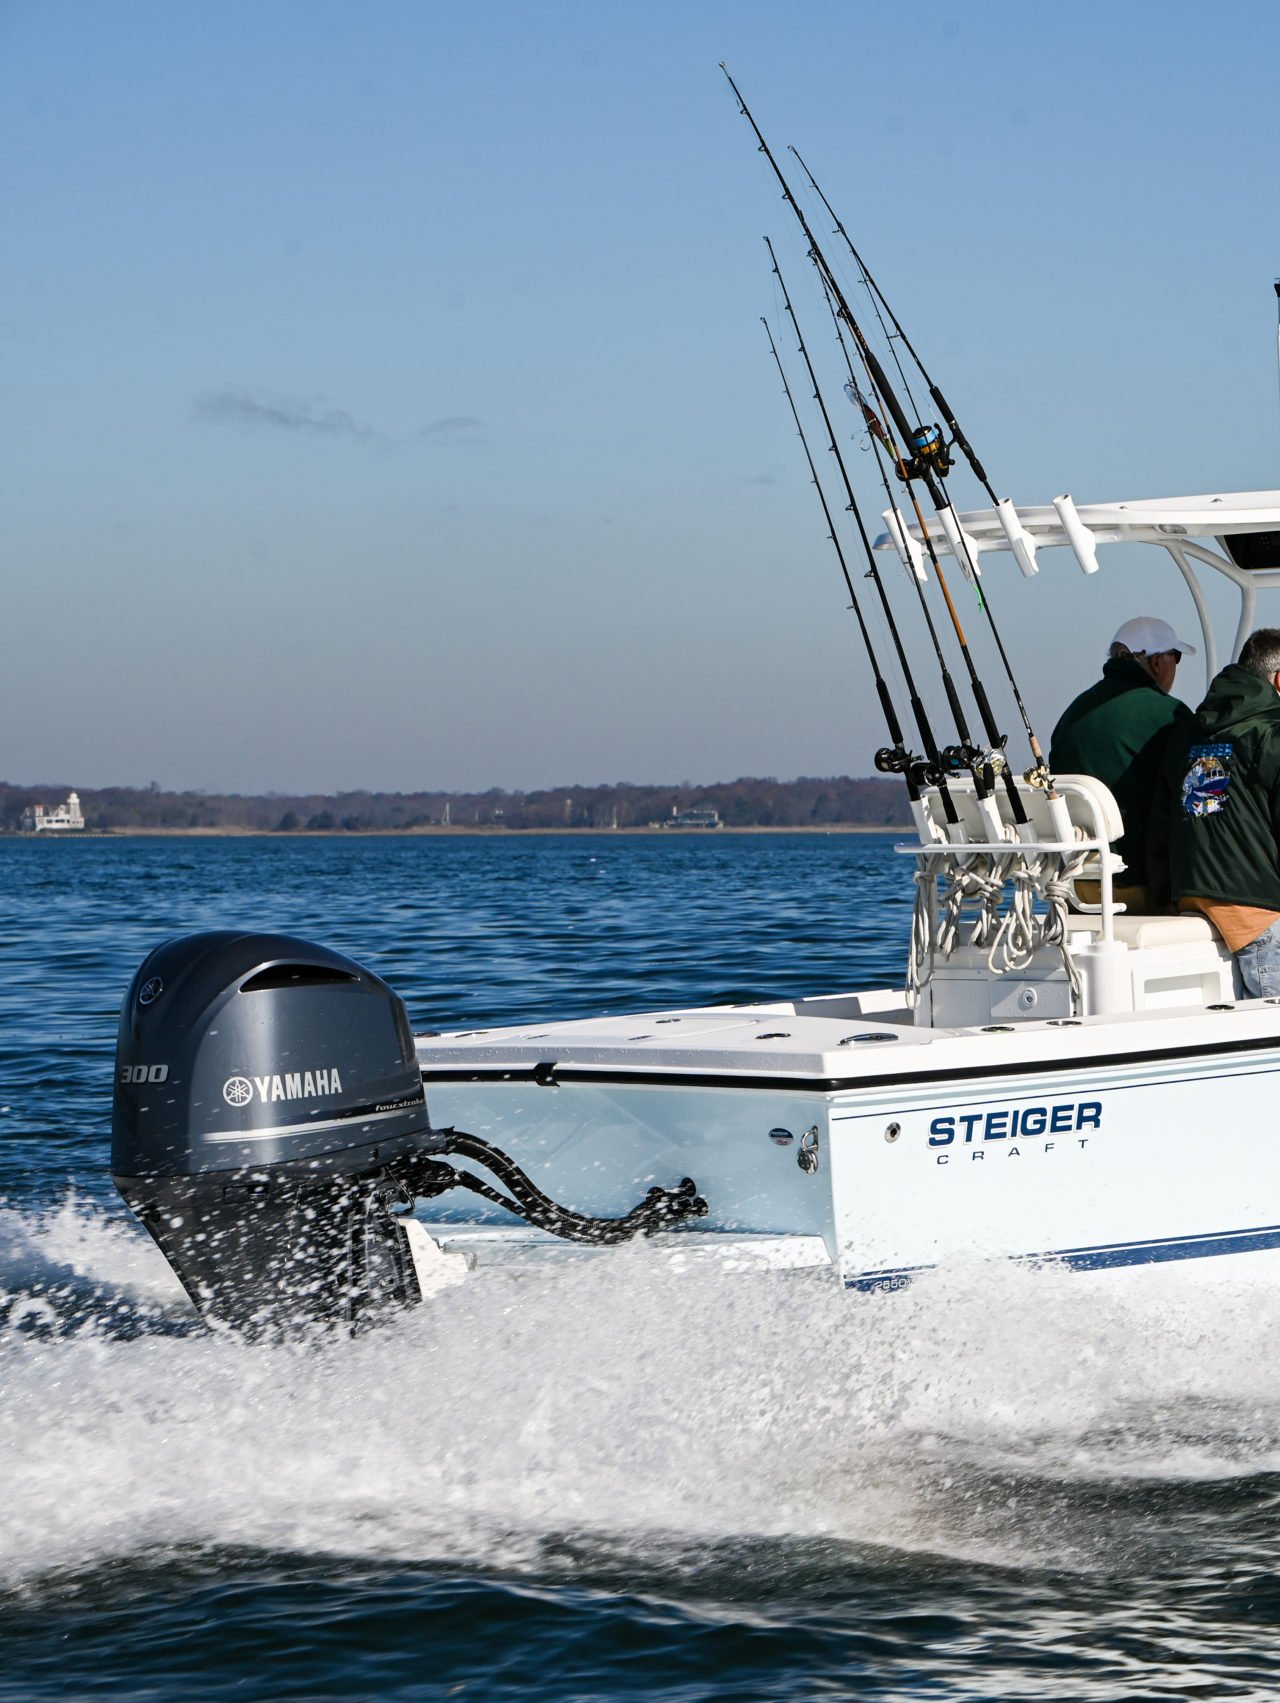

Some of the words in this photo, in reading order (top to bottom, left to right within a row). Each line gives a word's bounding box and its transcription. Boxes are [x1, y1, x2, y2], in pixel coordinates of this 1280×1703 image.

[120, 1064, 169, 1084] 300
[253, 1068, 343, 1103] YAMAHA
[928, 1101, 1103, 1147] STEIGER
[936, 1139, 1089, 1165] CRAFT
